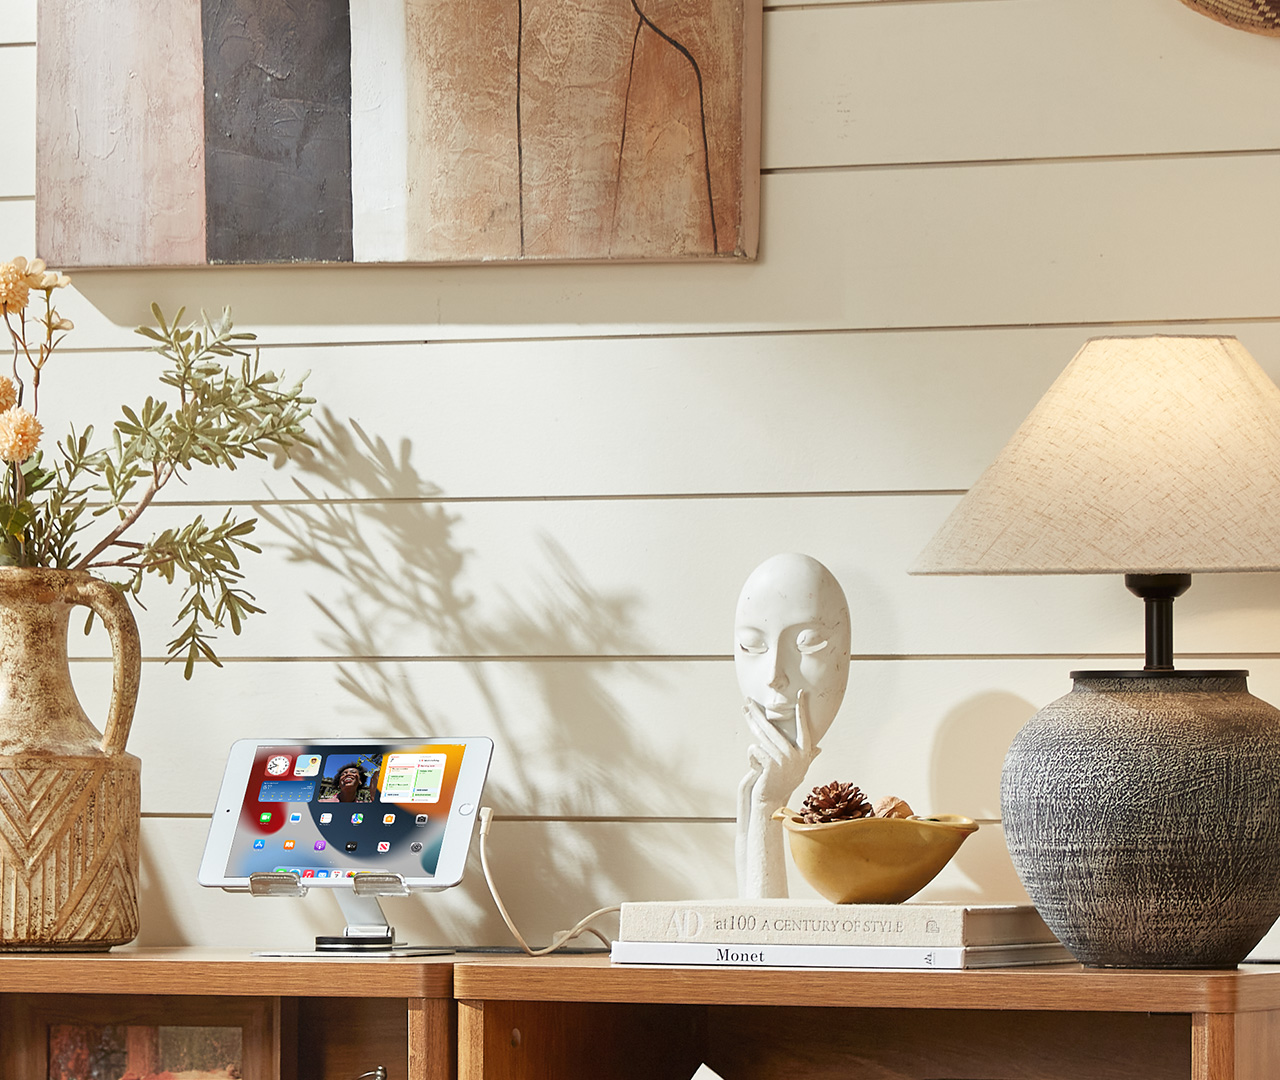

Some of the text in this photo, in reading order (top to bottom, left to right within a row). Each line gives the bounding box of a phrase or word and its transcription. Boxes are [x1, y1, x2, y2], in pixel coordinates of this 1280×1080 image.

[666, 909, 703, 939] AD
[761, 920, 771, 931] A
[774, 919, 840, 932] CENTURY
[842, 920, 861, 932] OF
[863, 921, 904, 933] STYLE
[716, 948, 765, 962] Monet
